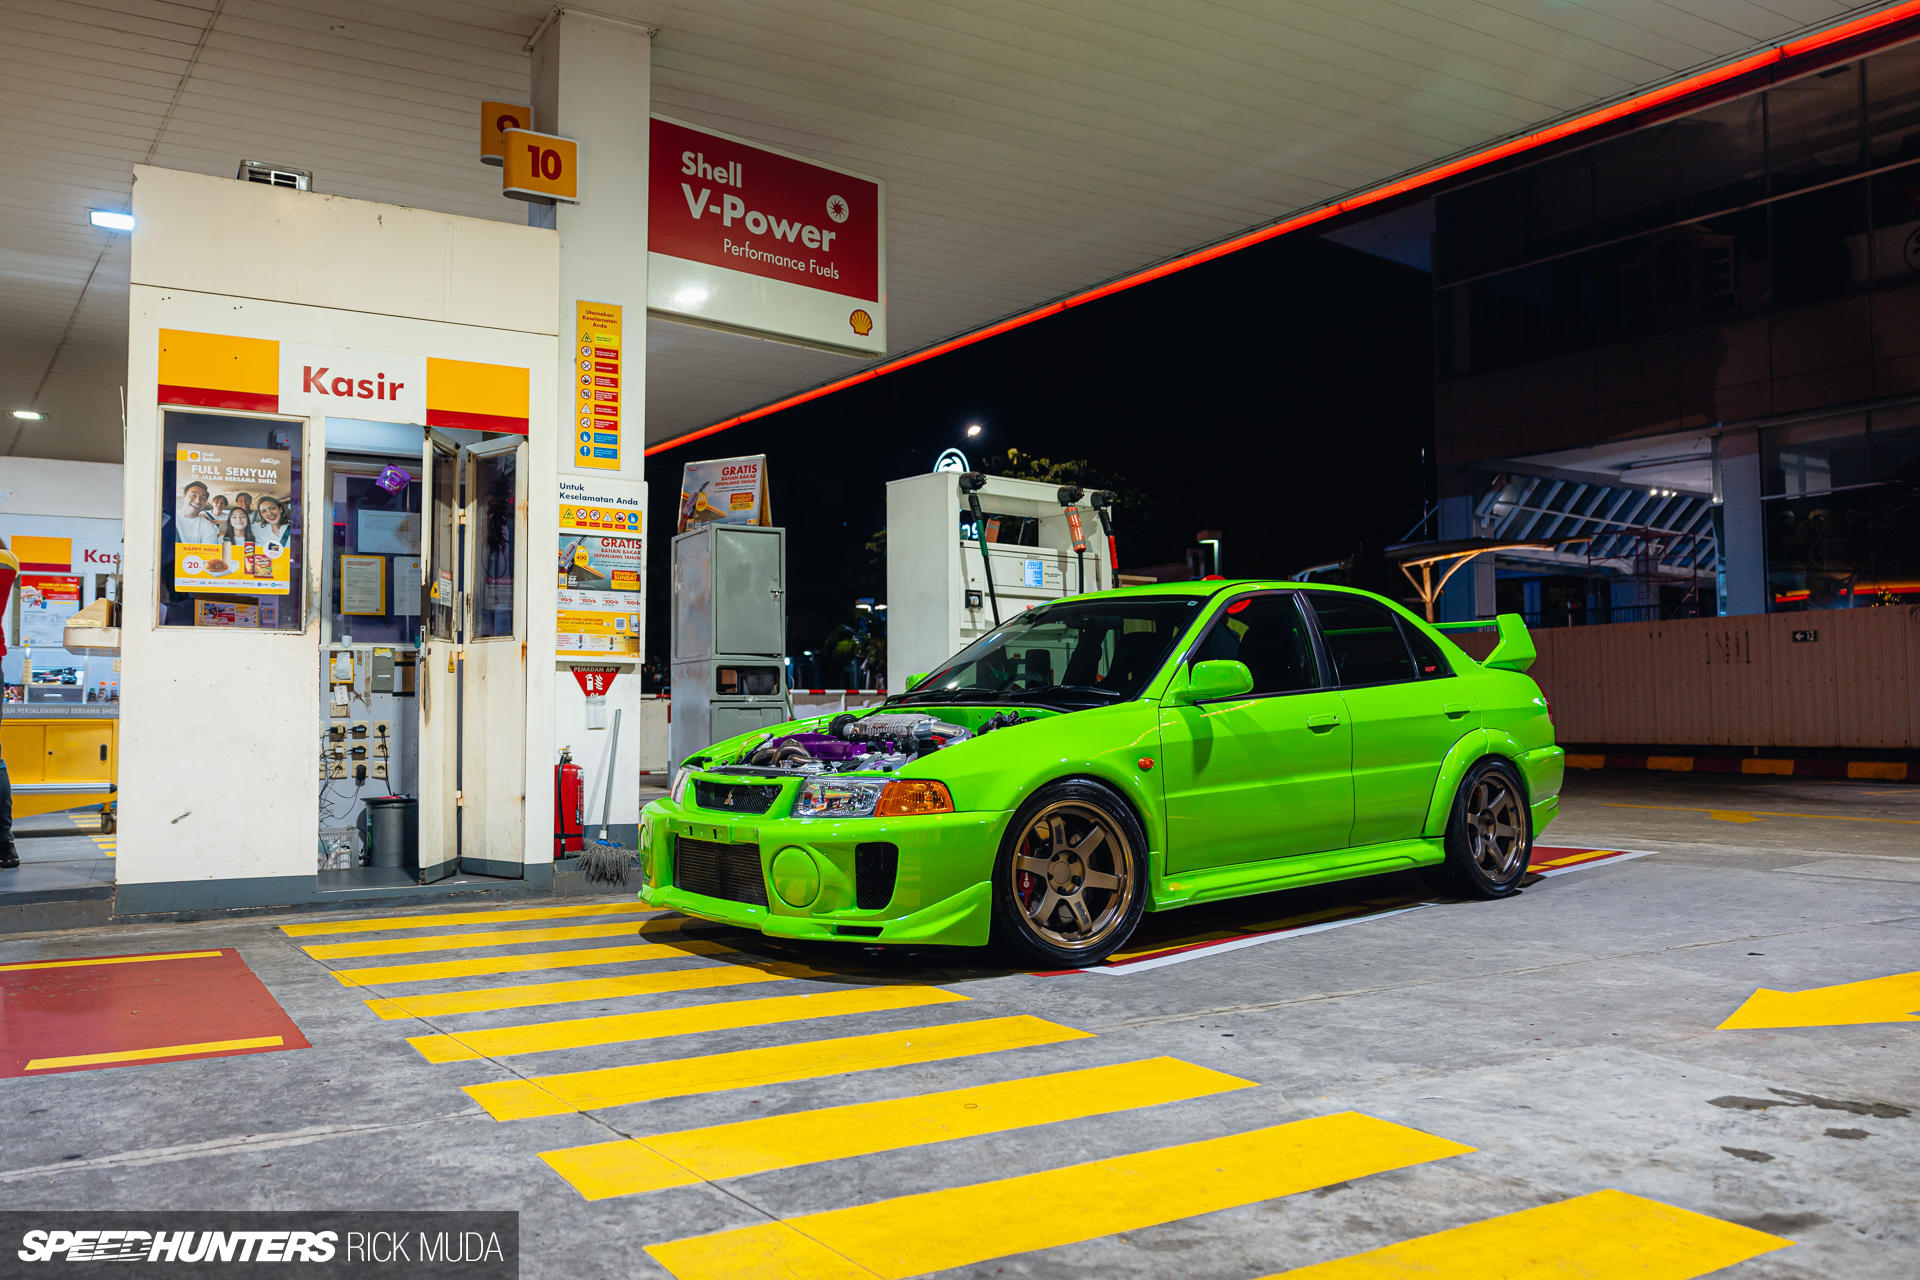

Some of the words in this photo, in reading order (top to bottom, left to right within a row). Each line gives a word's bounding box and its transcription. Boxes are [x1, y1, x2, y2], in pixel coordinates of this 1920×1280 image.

[527, 144, 562, 180] 10
[681, 150, 742, 188] Shell
[681, 182, 836, 252] V-Power
[723, 238, 806, 271] Performance
[809, 259, 839, 280] Fuels
[582, 315, 618, 324] Keselamatan
[585, 309, 614, 318] Utamakan
[303, 365, 404, 401] Kasir
[191, 464, 220, 475] FULL
[226, 466, 277, 479] SENYUM
[722, 464, 758, 476] GRATIS
[560, 482, 584, 491] Untuk
[560, 492, 614, 504] Keselamatan
[616, 497, 638, 506] Anda
[601, 538, 642, 550] GRATIS
[84, 549, 122, 564] Kas
